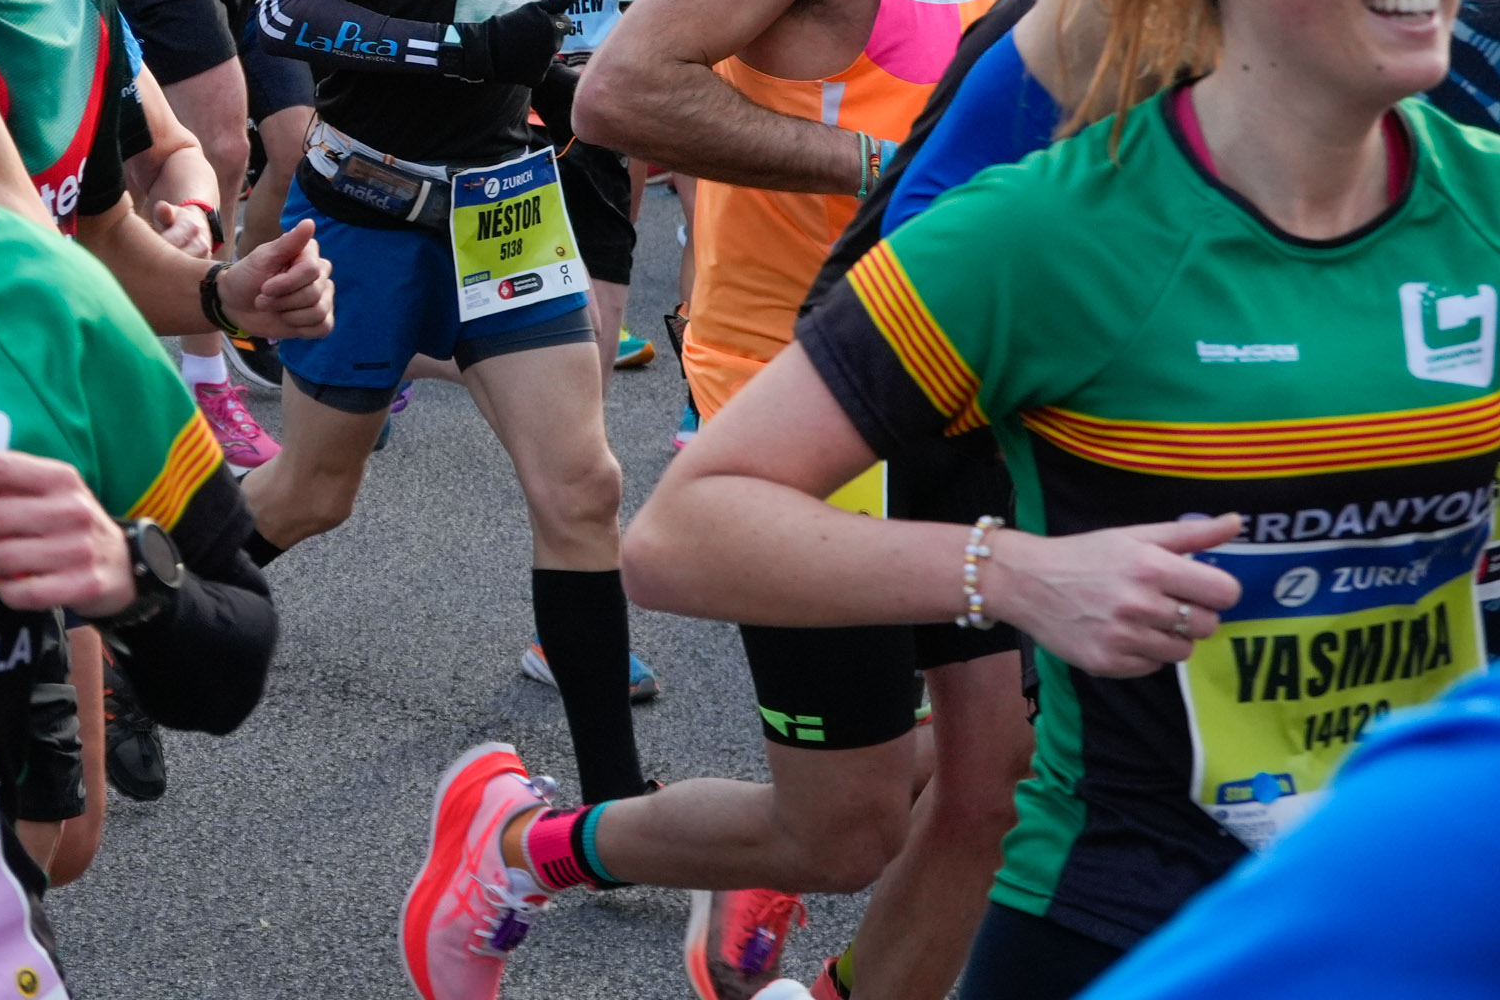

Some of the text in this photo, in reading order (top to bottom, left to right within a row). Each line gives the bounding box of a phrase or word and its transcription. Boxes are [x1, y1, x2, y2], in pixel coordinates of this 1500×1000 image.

[502, 169, 533, 190] ZURICH
[477, 195, 541, 241] NÉSTOR
[500, 238, 523, 261] 5138
[1230, 602, 1452, 704] YASMINA
[1303, 699, 1391, 751] 1442
